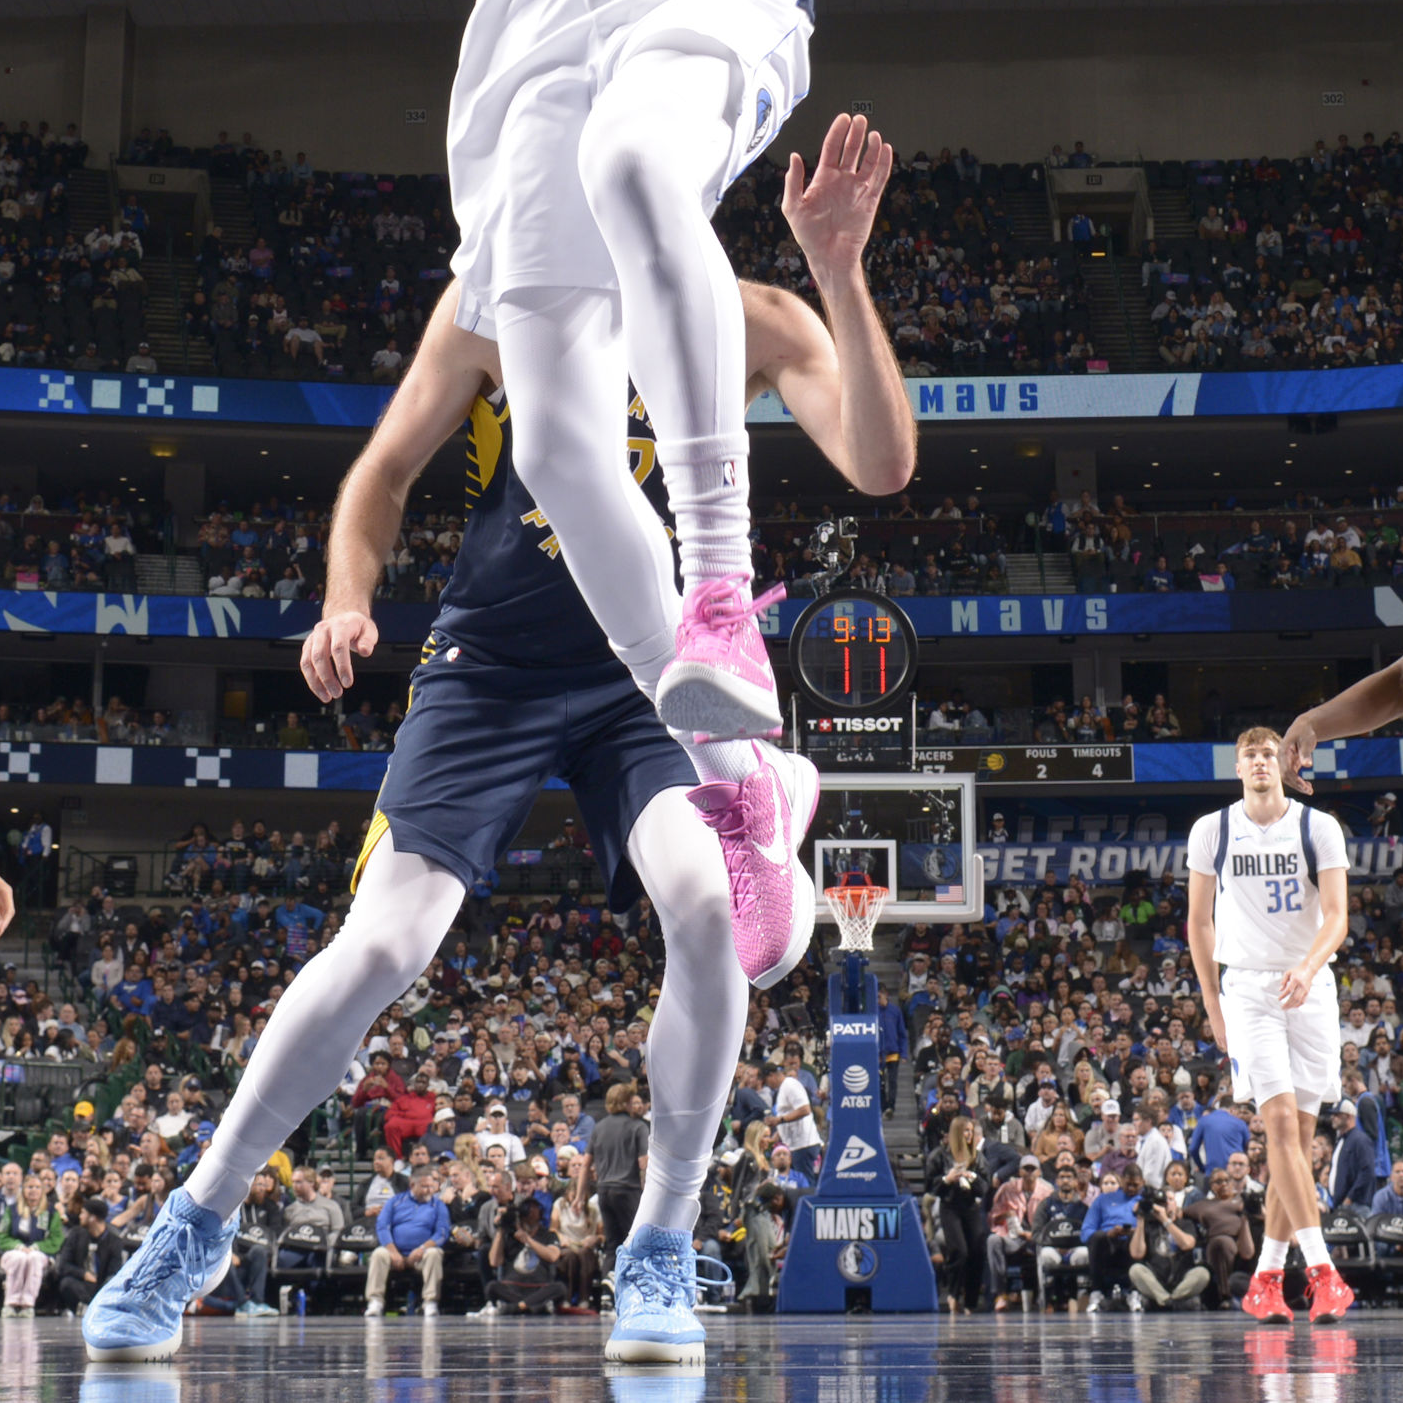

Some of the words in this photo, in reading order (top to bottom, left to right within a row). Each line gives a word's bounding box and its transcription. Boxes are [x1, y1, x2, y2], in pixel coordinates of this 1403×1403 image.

[853, 102, 872, 112] 301
[834, 616, 890, 643] 9:13
[844, 647, 885, 694] 11
[834, 717, 903, 732] TISSOT
[914, 751, 953, 762] PACERS
[1026, 748, 1057, 758] FOULS
[1072, 747, 1122, 758] TIMEOUTS
[1037, 764, 1047, 779] 2
[1092, 763, 1103, 778] 4
[980, 847, 1056, 880] GET
[1232, 854, 1297, 876] DALLAS
[1266, 880, 1302, 913] 32
[833, 1023, 876, 1036] PATH
[841, 1096, 872, 1108] AT&T
[816, 1207, 873, 1240] MAVS
[874, 1208, 897, 1238] TV
